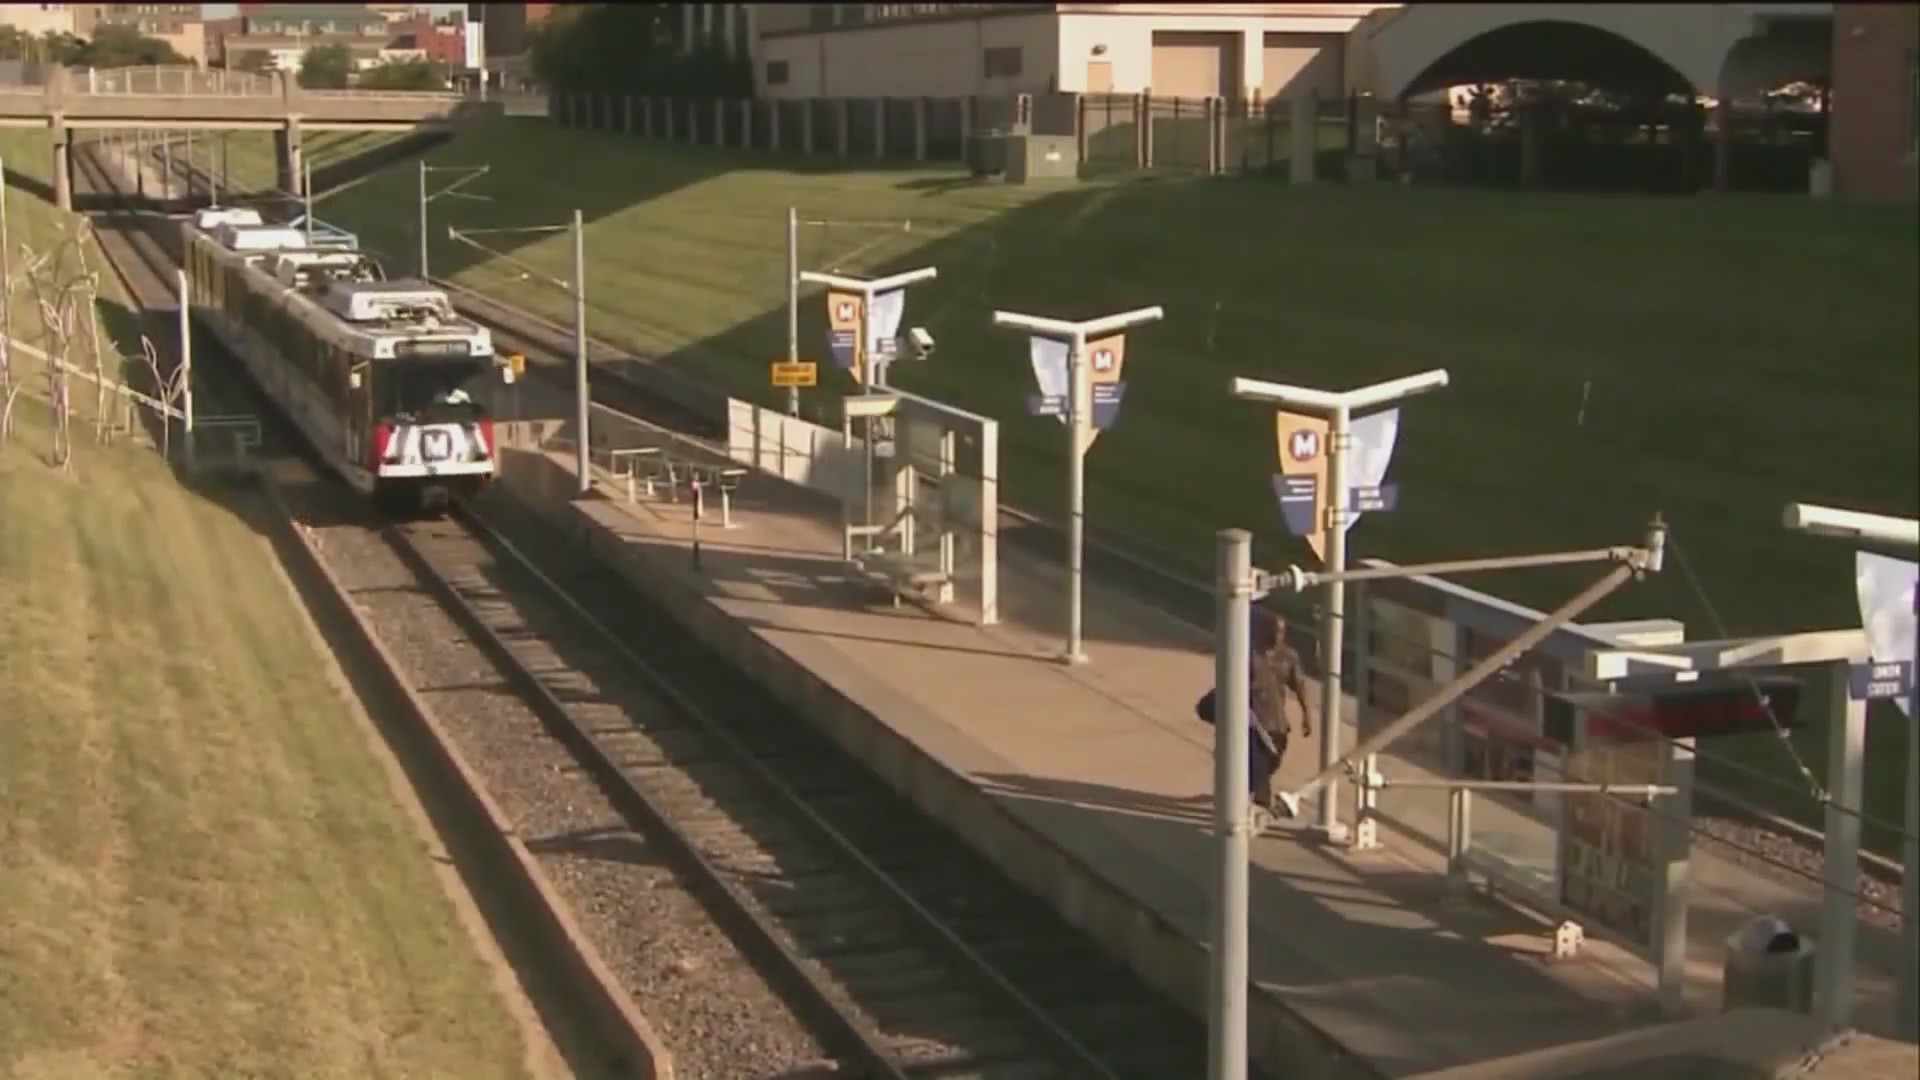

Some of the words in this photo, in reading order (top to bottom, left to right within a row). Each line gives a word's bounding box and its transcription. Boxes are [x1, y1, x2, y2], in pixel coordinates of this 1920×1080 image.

[1094, 350, 1112, 369] M
[423, 433, 449, 459] M
[1293, 431, 1316, 456] M
